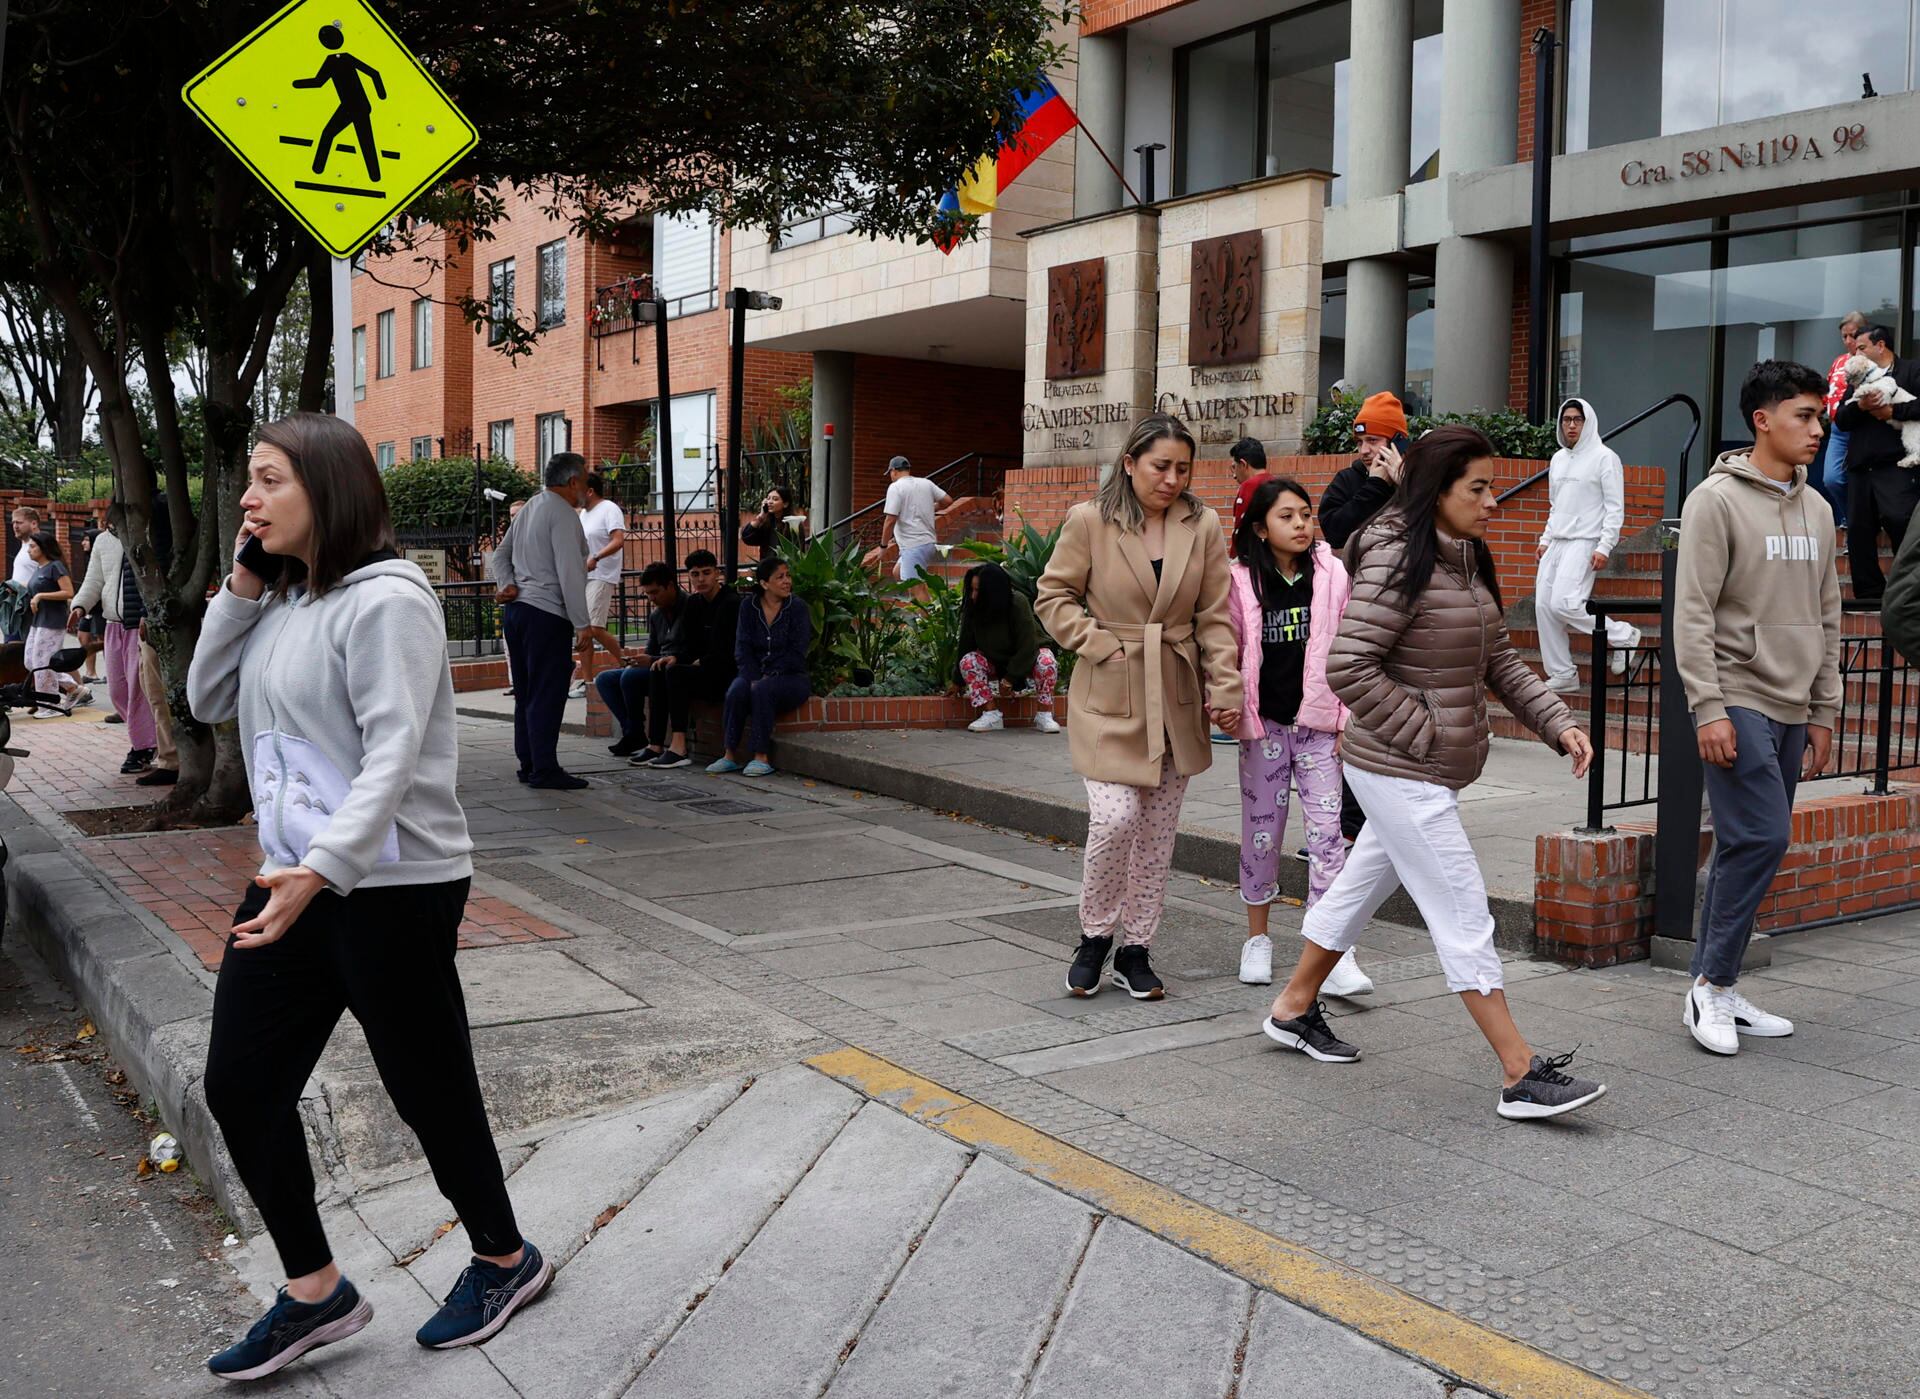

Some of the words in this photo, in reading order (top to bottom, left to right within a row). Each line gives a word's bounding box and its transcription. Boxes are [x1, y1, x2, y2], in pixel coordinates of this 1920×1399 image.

[1620, 160, 1674, 187] Cra.
[1680, 150, 1711, 178] 58
[1833, 122, 1868, 154] 98
[1022, 401, 1130, 432] CAMPESTRE
[1156, 391, 1296, 422] CAMPESTRE
[1765, 535, 1818, 561] PUMA
[1264, 607, 1309, 627] IMITE
